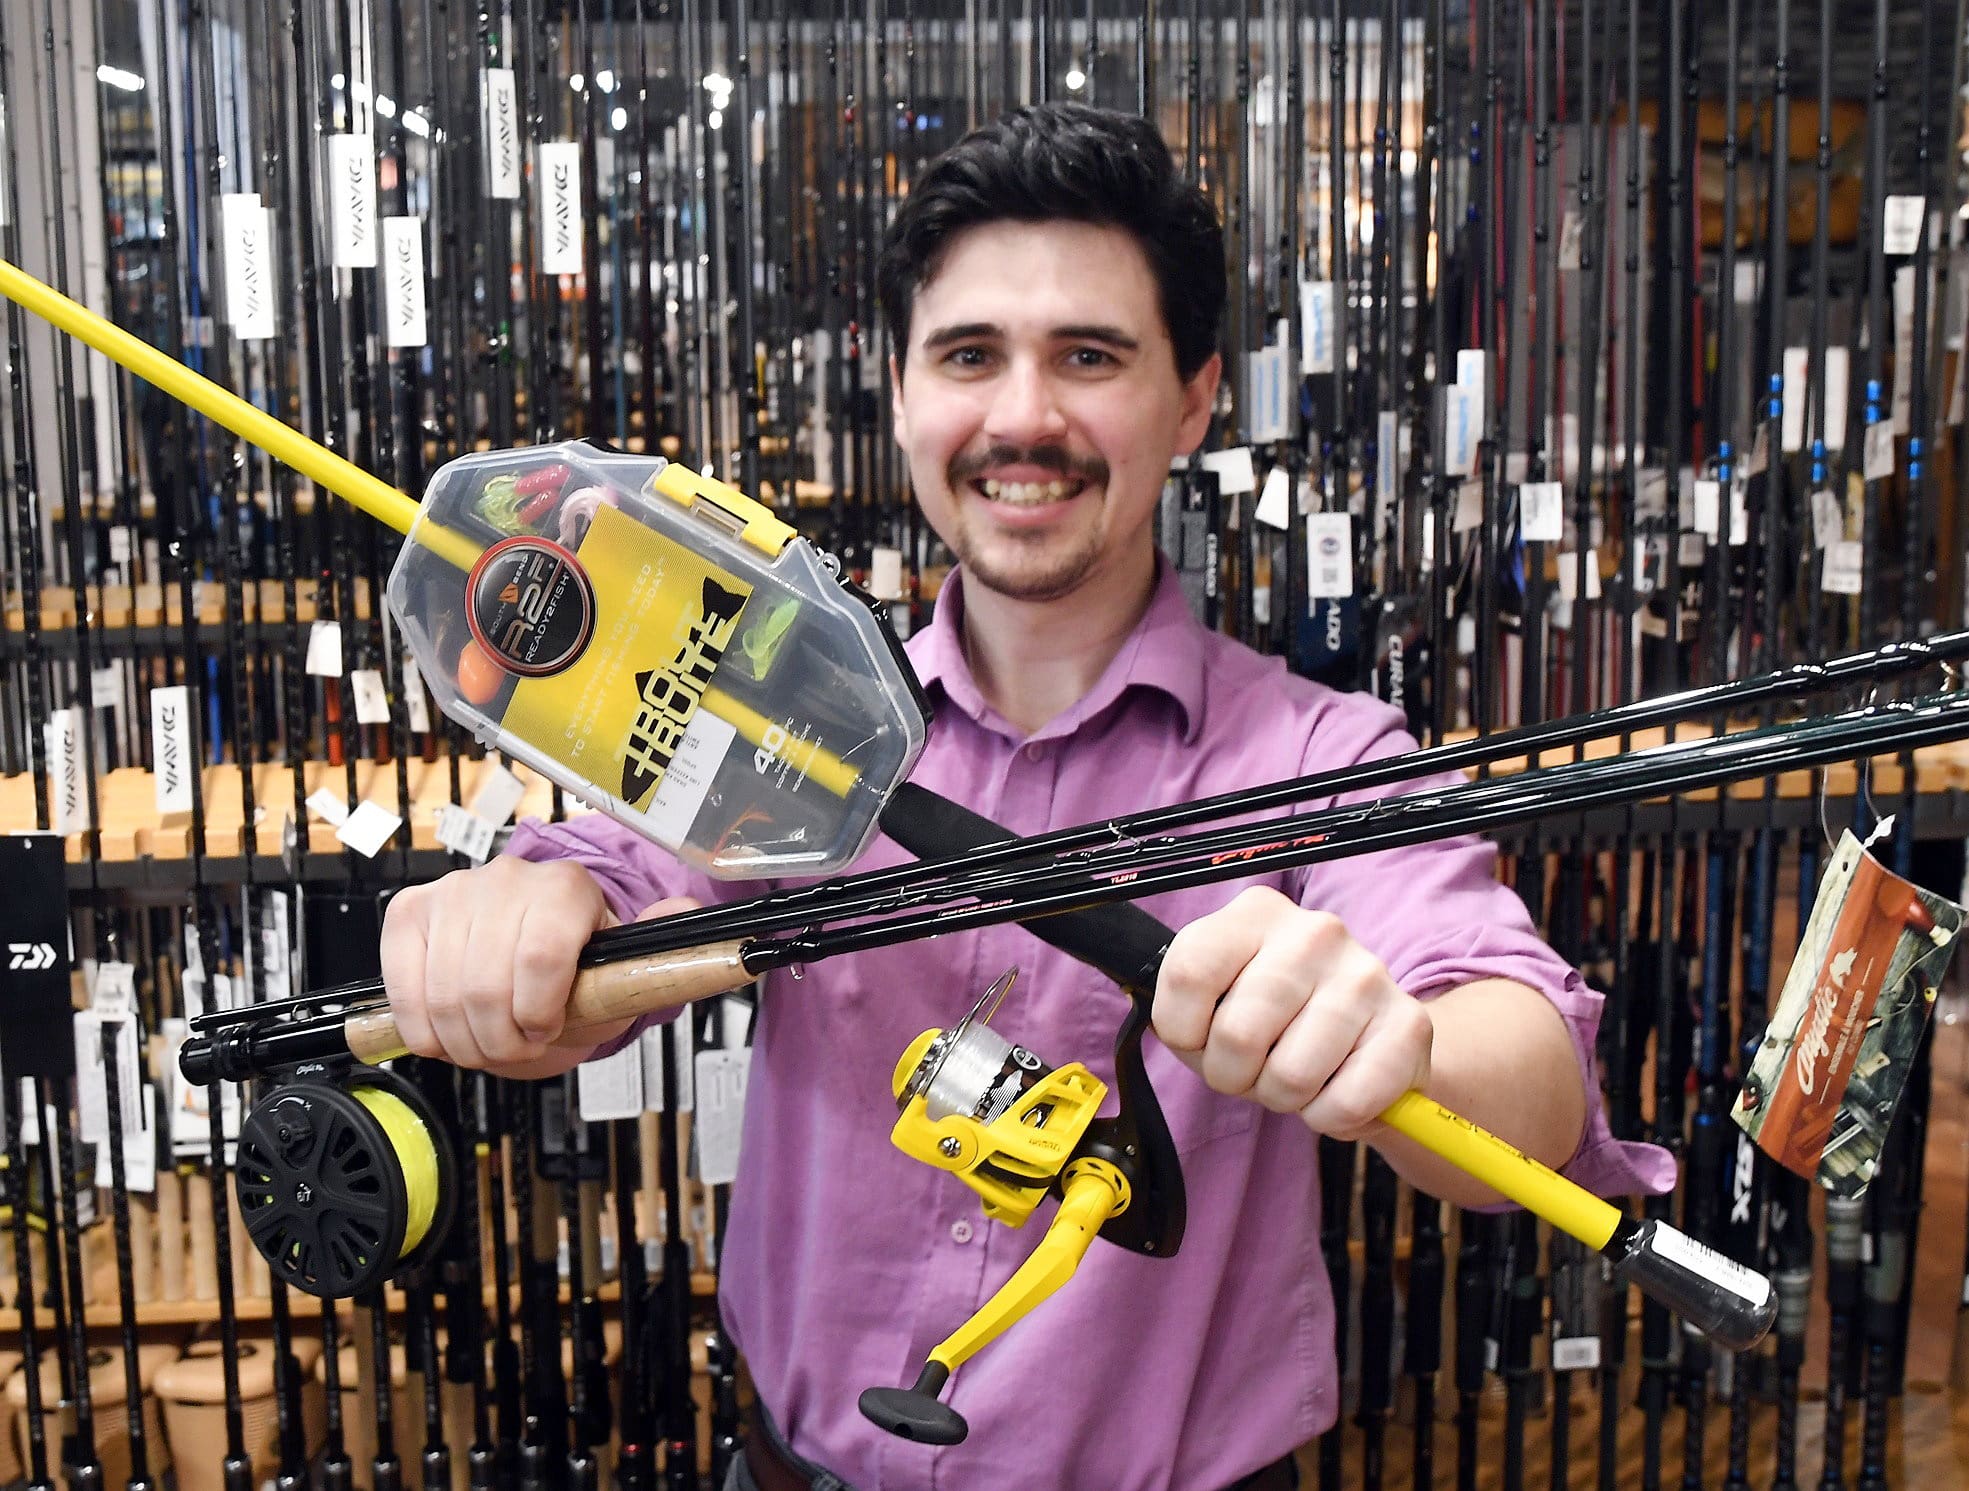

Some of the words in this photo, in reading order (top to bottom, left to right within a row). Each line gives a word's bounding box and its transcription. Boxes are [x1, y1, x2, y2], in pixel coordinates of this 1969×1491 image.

[490, 602, 508, 635] SOUTH
[512, 553, 531, 584] BEND
[525, 572, 572, 662] READY2FISH
[564, 646, 614, 739] EVERYTHING
[608, 609, 630, 643] YOU
[626, 563, 653, 606] NEED
[571, 738, 586, 758] TO
[581, 689, 608, 737] START
[604, 622, 640, 685] FISHING
[612, 600, 715, 763] TROUT
[634, 611, 733, 777] TRUITE
[752, 723, 787, 775] 40
